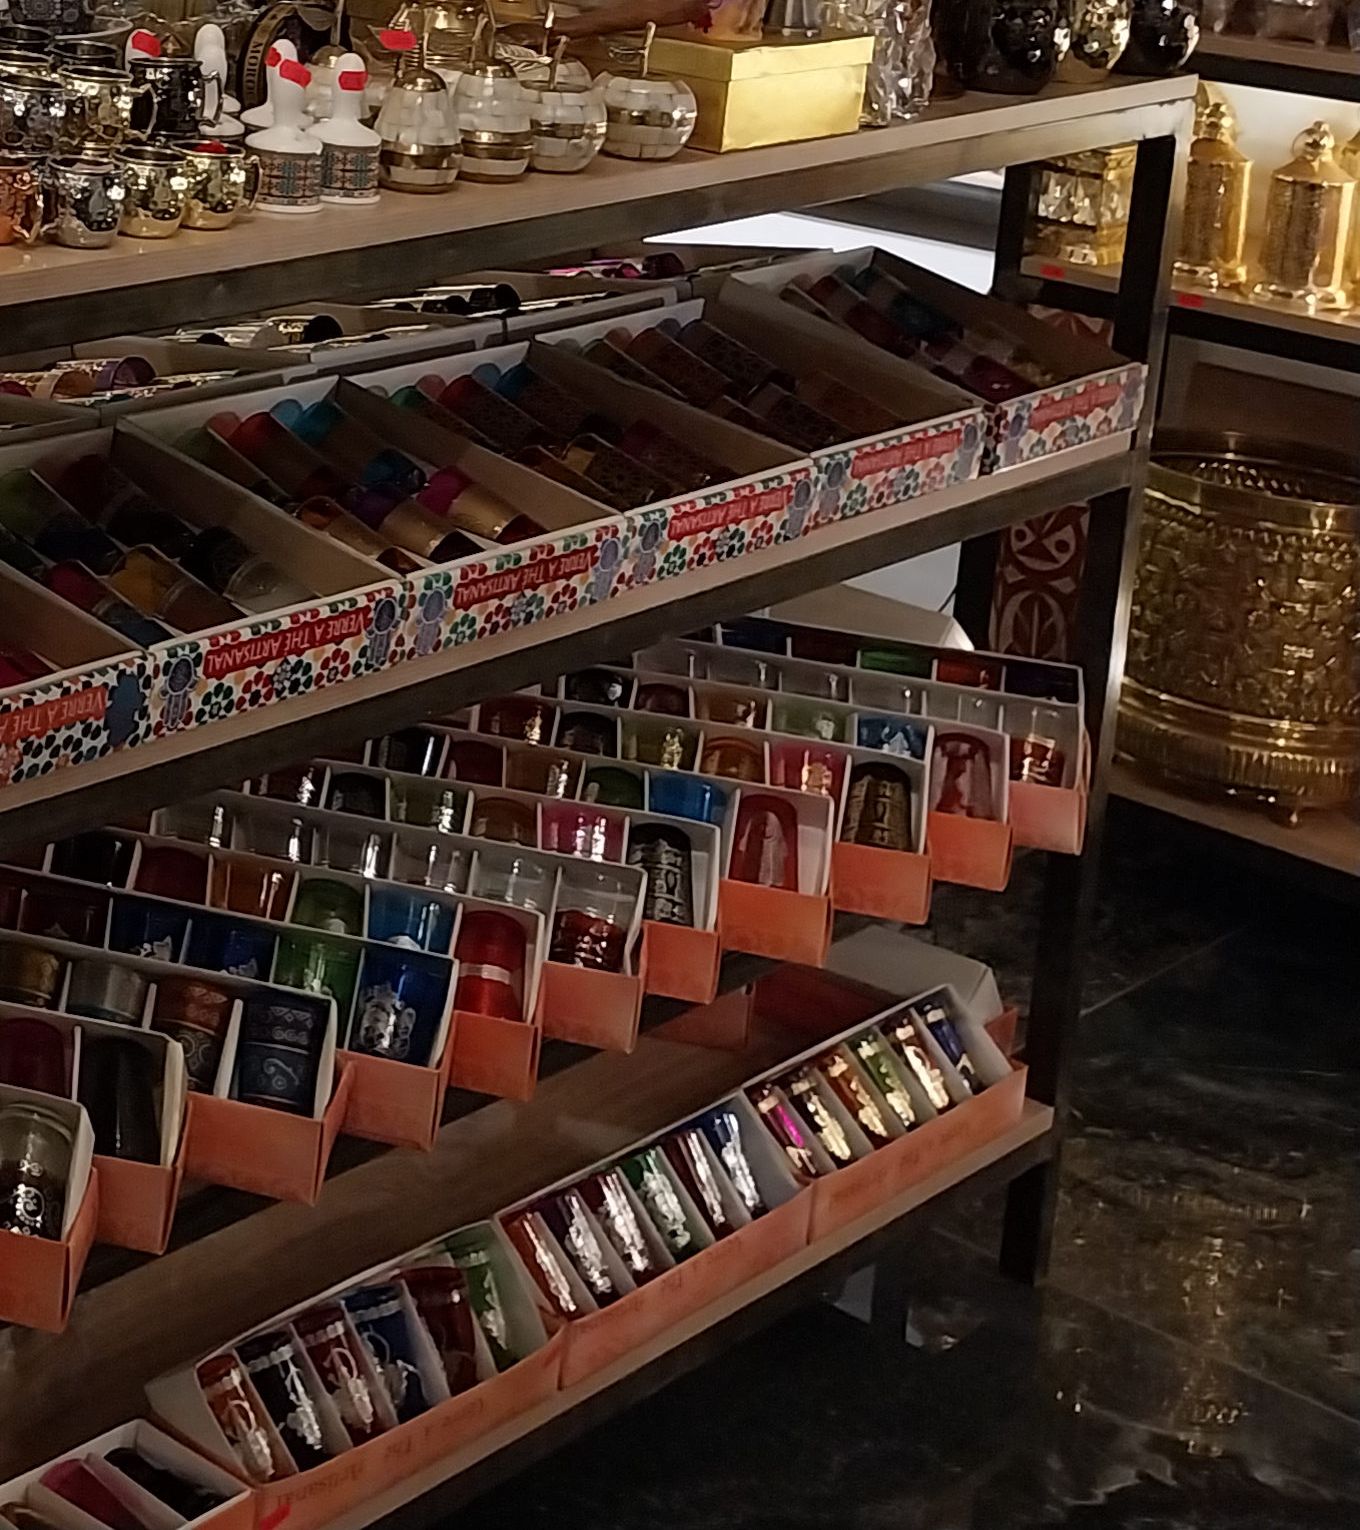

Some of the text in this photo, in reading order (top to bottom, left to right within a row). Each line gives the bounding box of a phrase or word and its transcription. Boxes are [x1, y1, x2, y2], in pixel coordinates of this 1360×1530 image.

[328, 611, 365, 636] VERRE
[207, 637, 280, 671] ARTISANAL
[61, 690, 105, 719] VERRE
